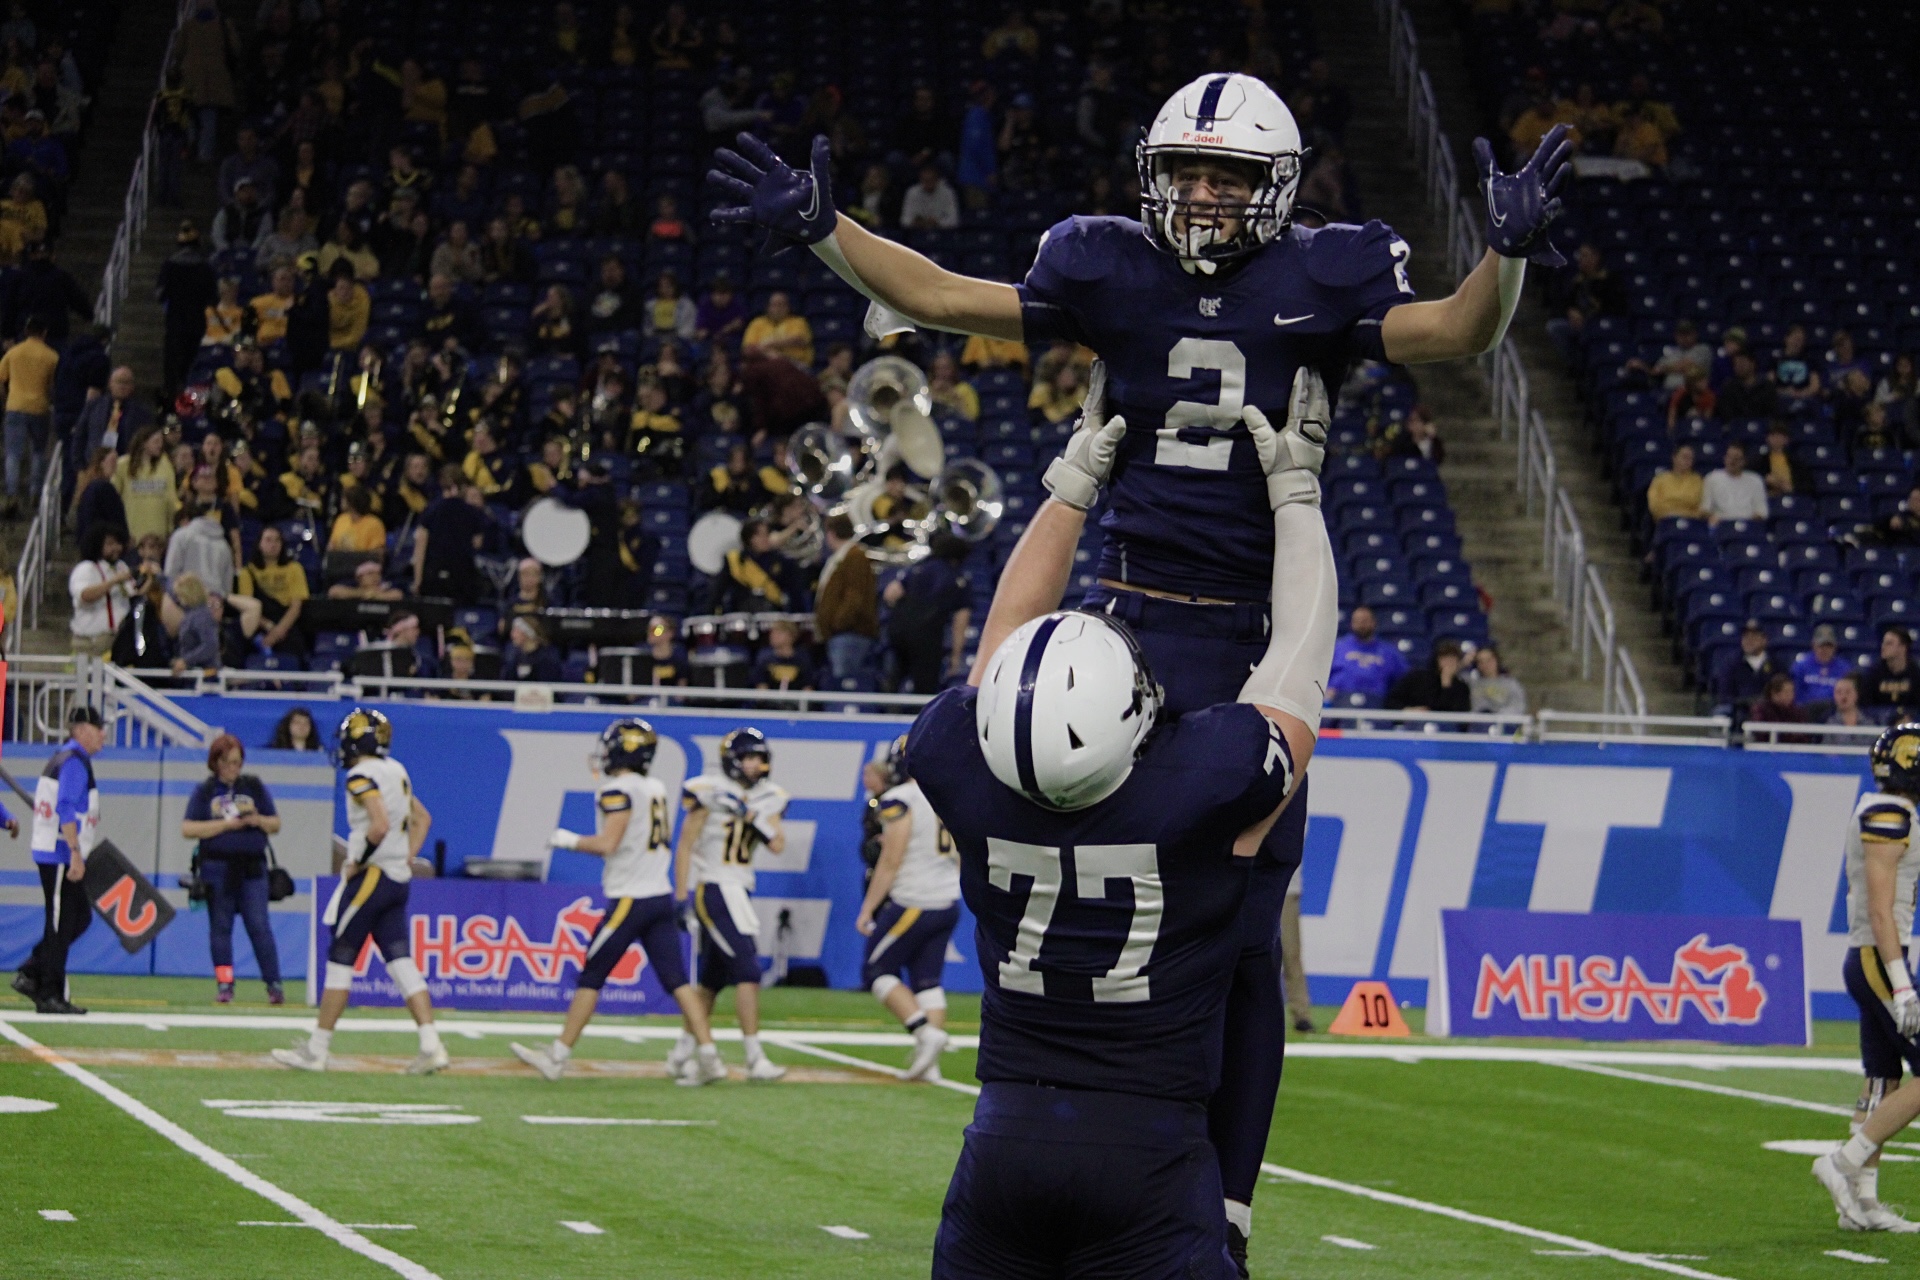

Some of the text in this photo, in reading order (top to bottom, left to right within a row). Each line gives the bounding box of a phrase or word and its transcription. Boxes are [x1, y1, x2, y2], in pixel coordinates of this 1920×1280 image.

[1155, 337, 1246, 471] 2
[986, 837, 1165, 1003] 77
[1359, 993, 1389, 1028] 10
[1472, 952, 1728, 1025] MHSAA
